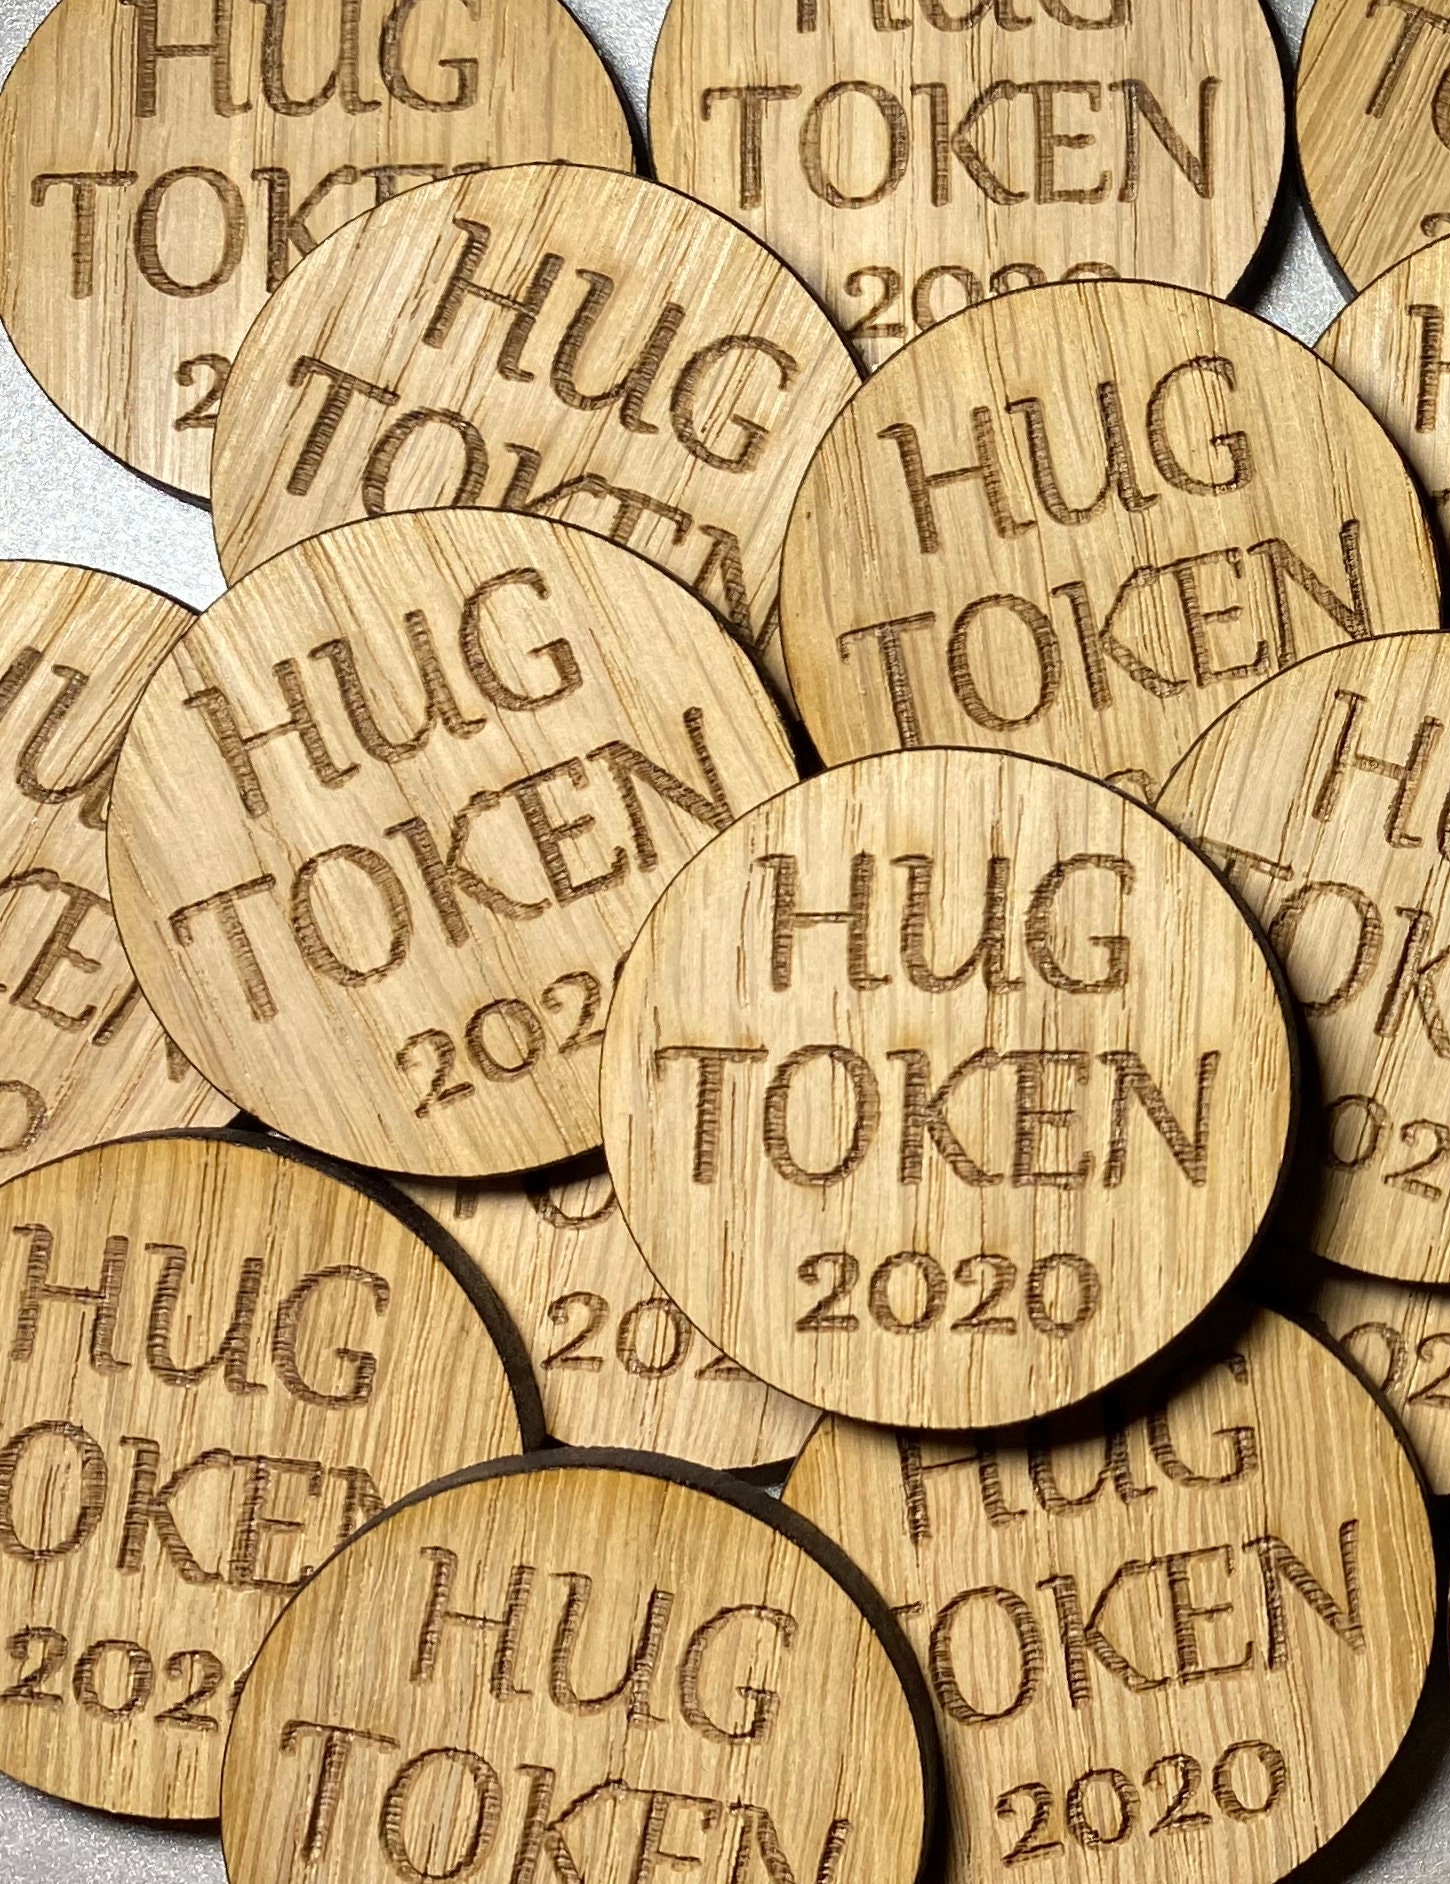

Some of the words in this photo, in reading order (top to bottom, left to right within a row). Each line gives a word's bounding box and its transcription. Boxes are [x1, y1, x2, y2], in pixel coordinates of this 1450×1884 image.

[118, 0, 484, 118] HUG
[701, 76, 1222, 209] TOKEN
[31, 160, 492, 300] TOK
[843, 262, 1122, 338] 20
[423, 216, 799, 474] HUG
[877, 354, 1256, 556] HUG
[184, 567, 584, 818] HUG
[836, 519, 1374, 750] TOKEN
[169, 707, 735, 1023] TOKEN
[753, 850, 1137, 994] HUG
[398, 956, 628, 1118] 202
[655, 1043, 1222, 1189] TOKEN
[9, 1222, 391, 1411] HUG
[540, 1290, 762, 1382] 20
[796, 1251, 1103, 1339] 2020
[0, 1419, 387, 1598] OKE
[0, 1625, 248, 1734] 202
[408, 1545, 799, 1746] HUG
[888, 1518, 1367, 1728] OKEN
[996, 1739, 1288, 1868] 2020
